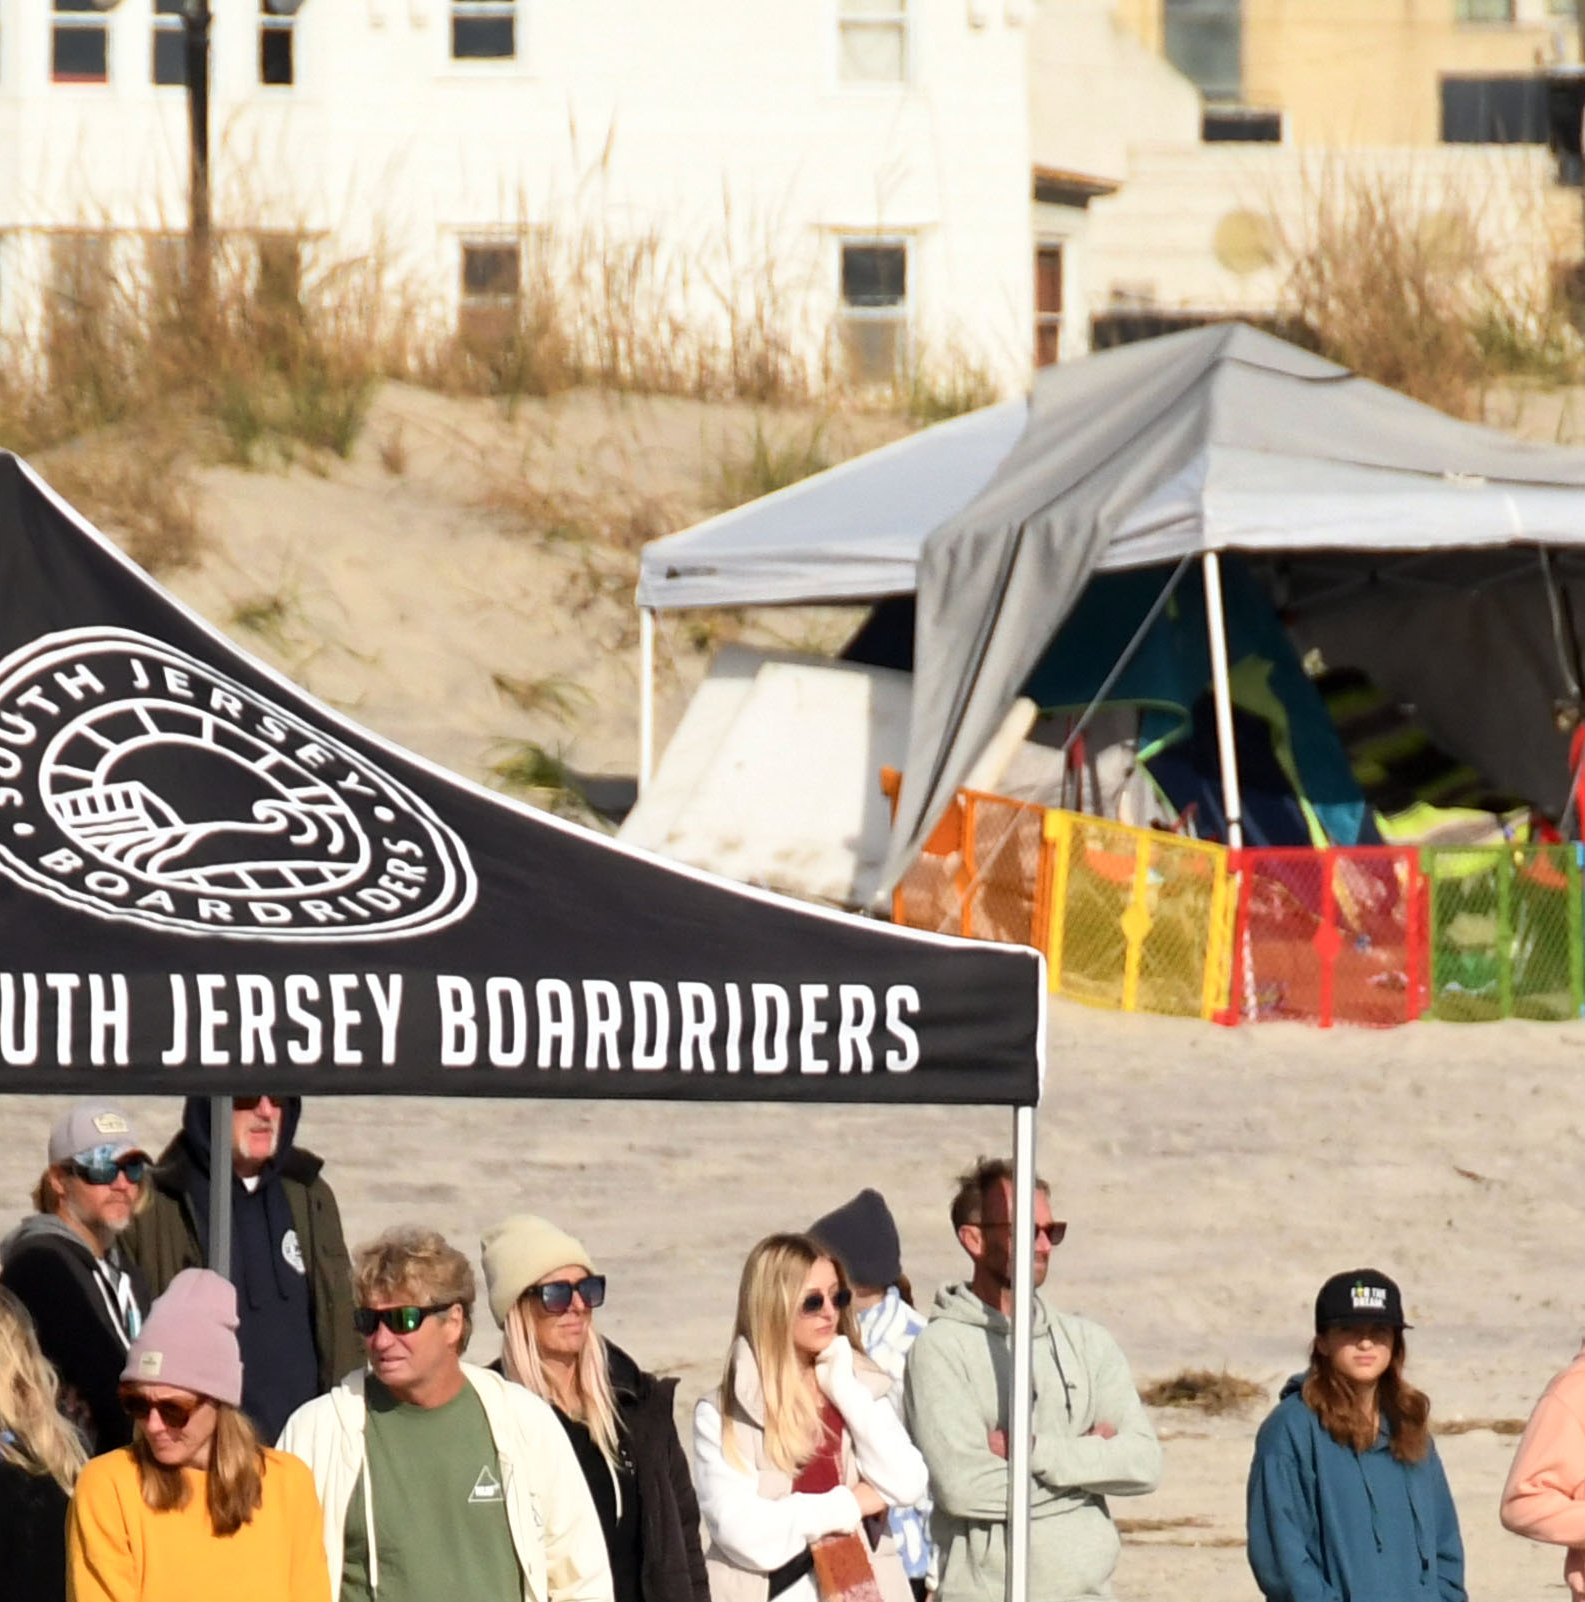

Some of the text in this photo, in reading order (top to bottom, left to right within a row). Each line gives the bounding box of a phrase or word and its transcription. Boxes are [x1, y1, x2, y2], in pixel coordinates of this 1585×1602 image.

[130, 658, 377, 796] JERSEY
[38, 837, 428, 924] BOARDRIDERS
[161, 973, 403, 1066] JERSEY
[436, 974, 921, 1074] BOARDRIDERS
